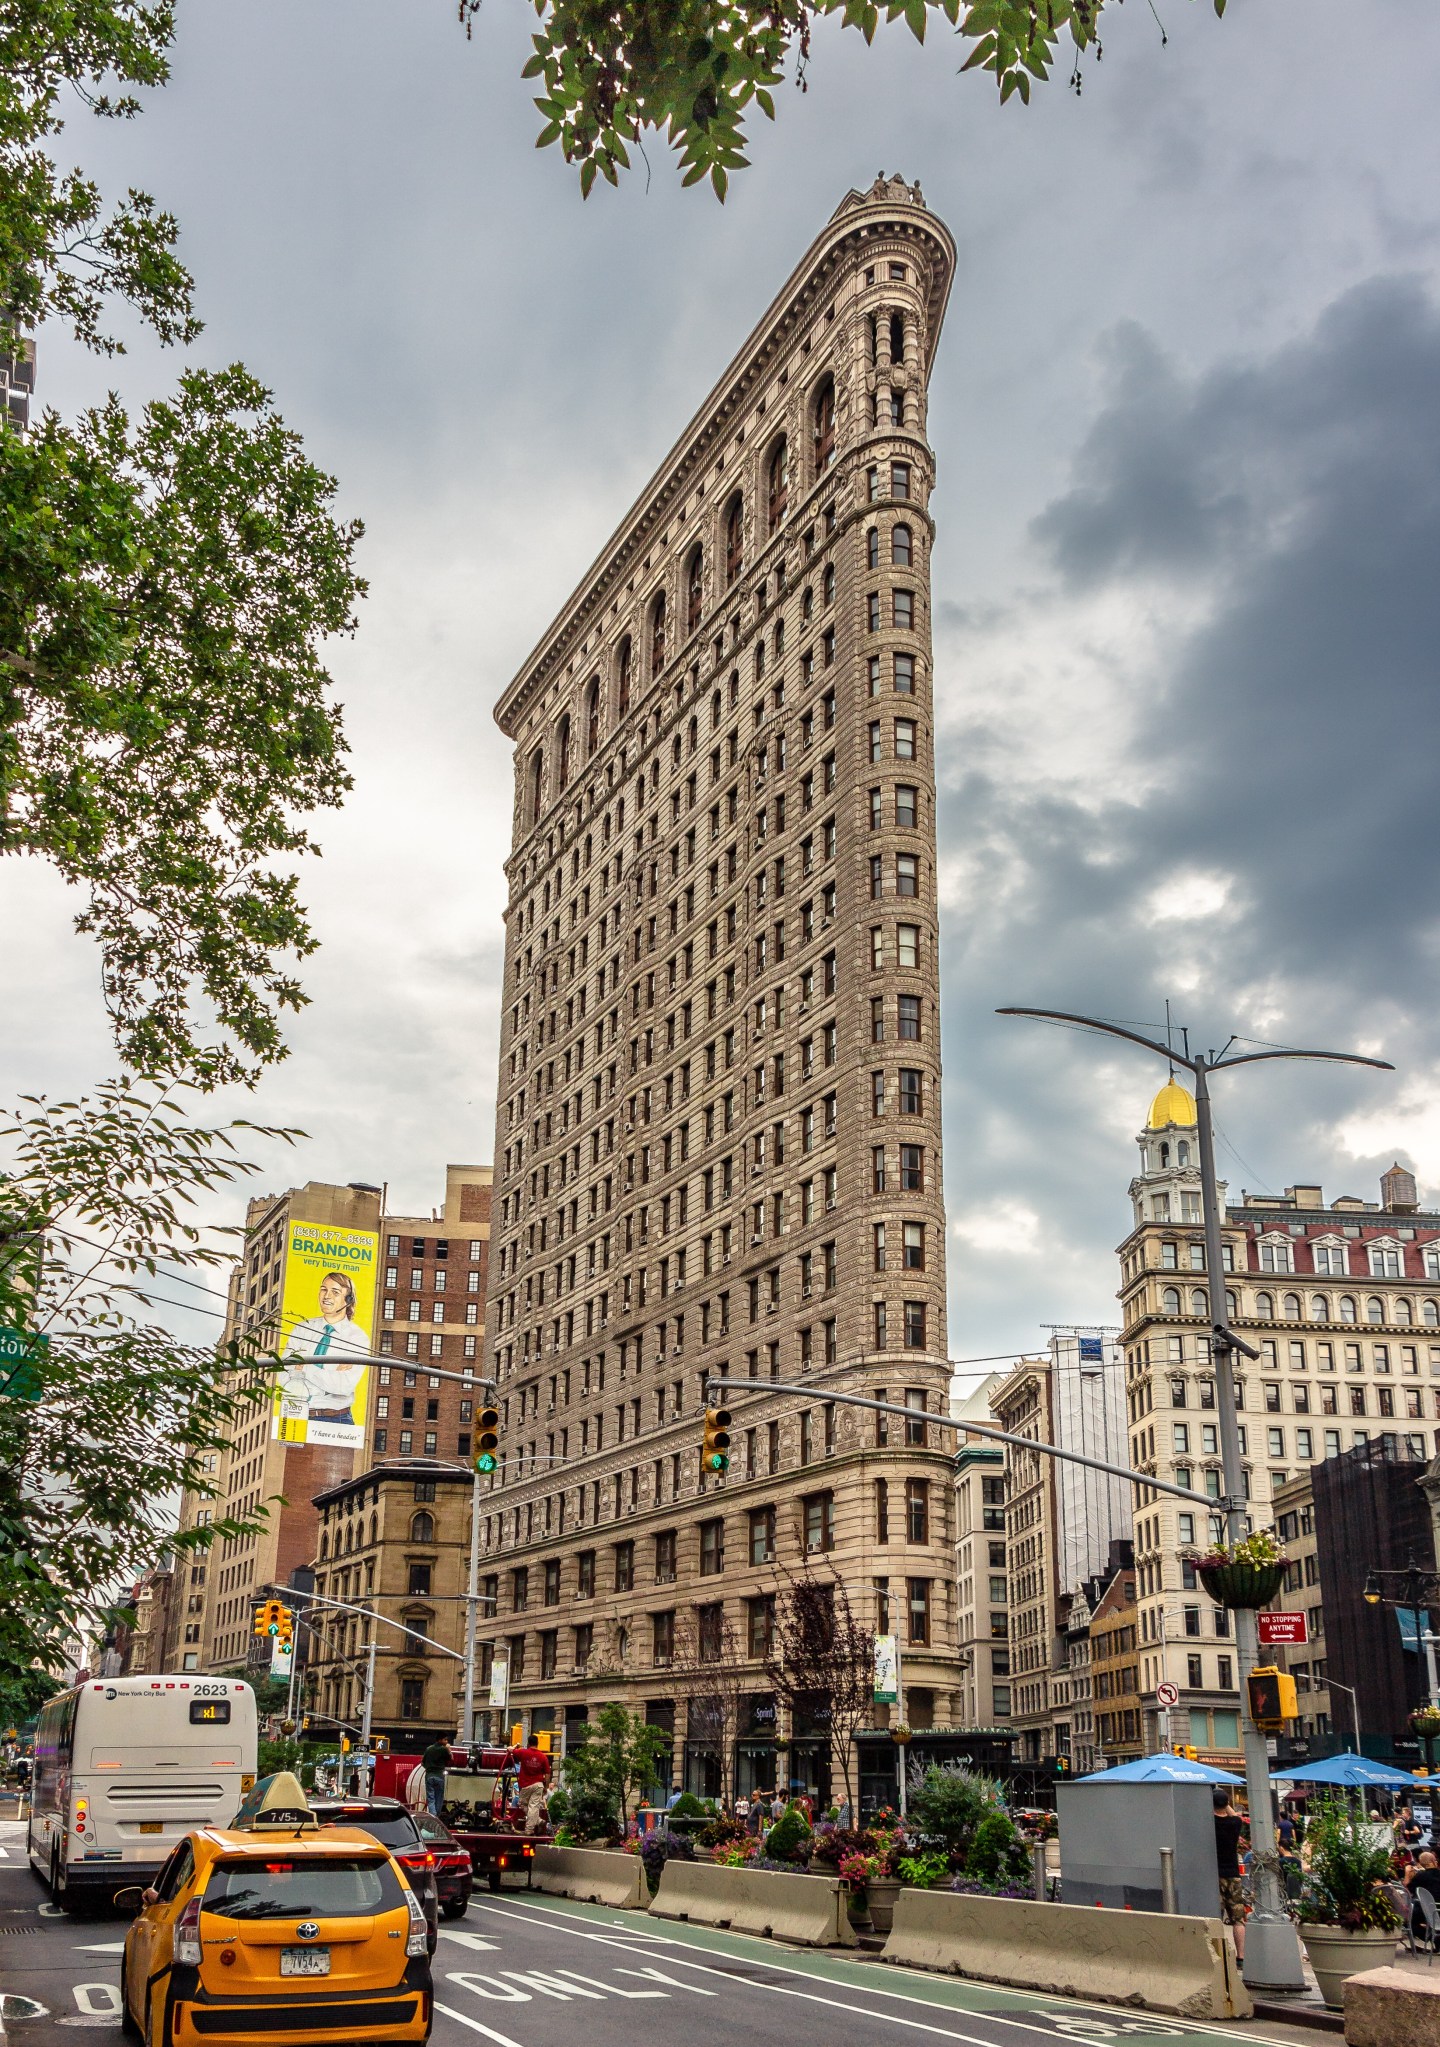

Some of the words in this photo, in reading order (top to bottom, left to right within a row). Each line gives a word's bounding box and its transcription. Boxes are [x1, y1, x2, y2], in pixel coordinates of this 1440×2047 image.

[293, 1226, 320, 1240] (833)
[322, 1231, 374, 1247] 477-8339
[292, 1238, 373, 1262] BRANDON
[303, 1258, 320, 1267] very
[322, 1259, 341, 1271] busy
[342, 1264, 360, 1272] man
[1271, 1615, 1302, 1623] STOPPING
[194, 1684, 228, 1696] 2623
[756, 1707, 773, 1720] Sprint
[445, 1967, 719, 2002] ONLY
